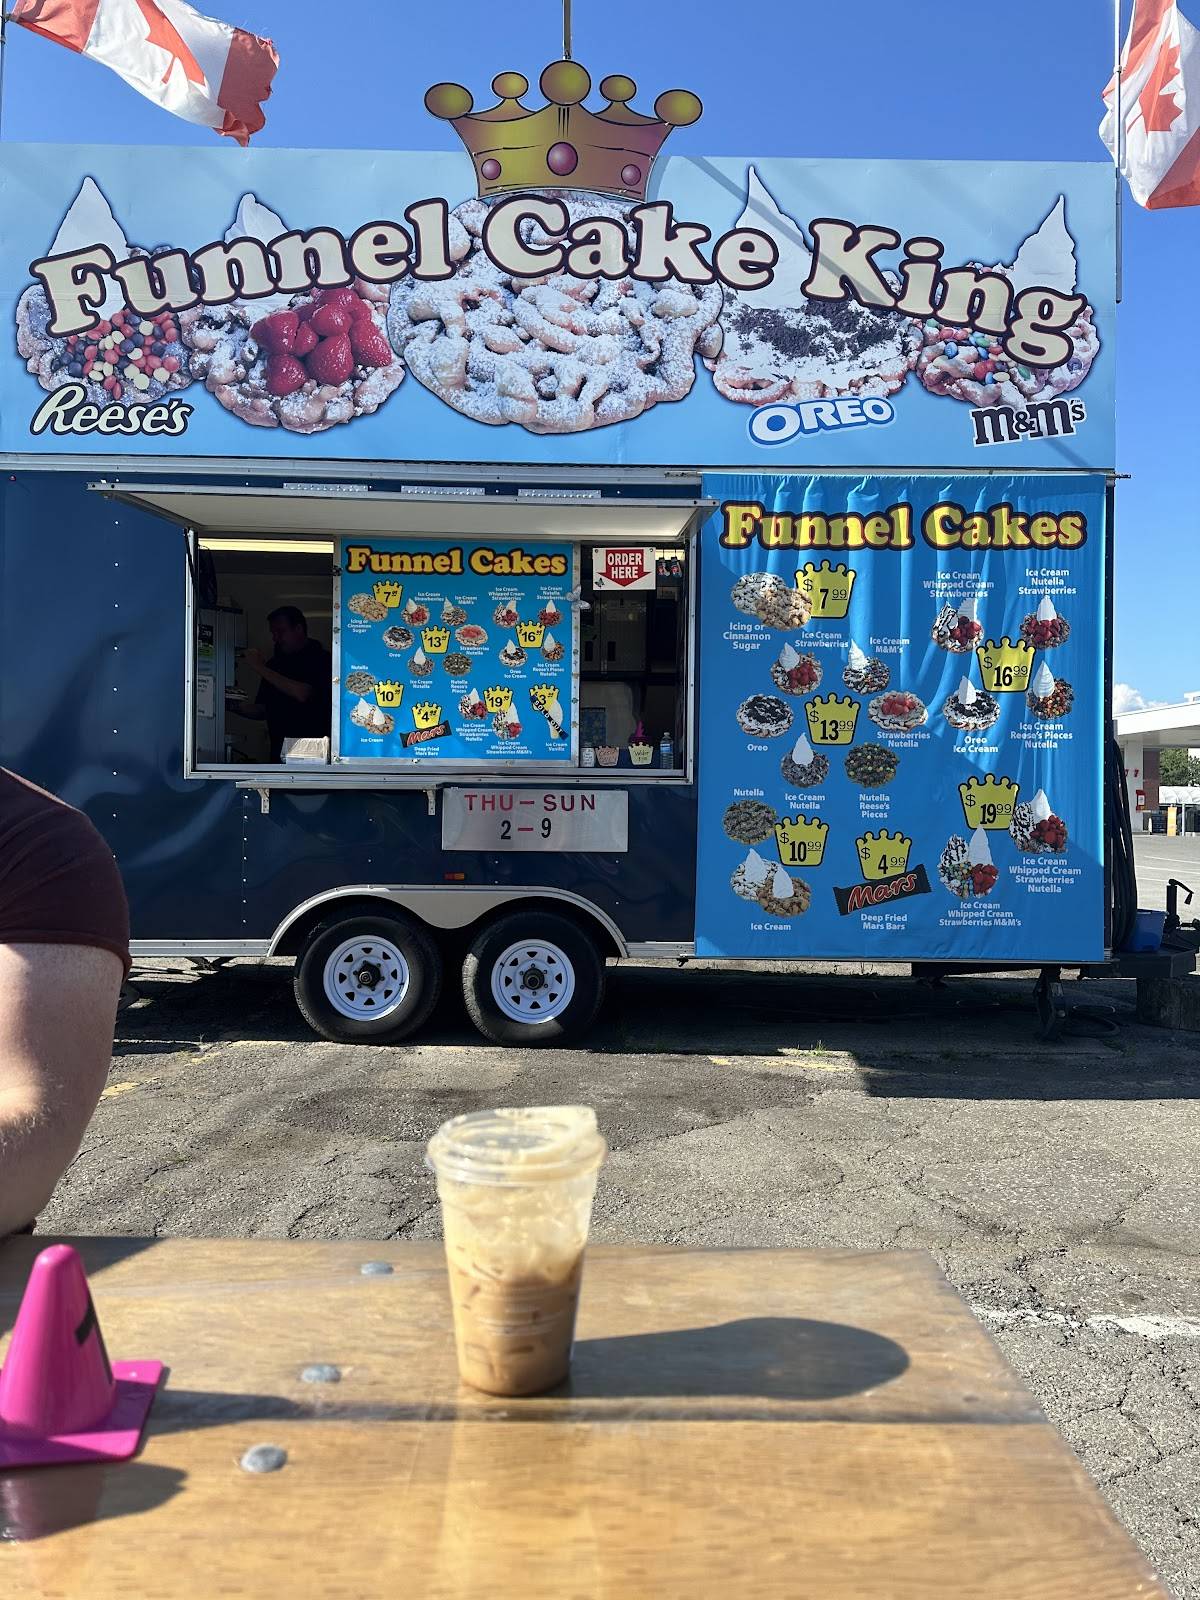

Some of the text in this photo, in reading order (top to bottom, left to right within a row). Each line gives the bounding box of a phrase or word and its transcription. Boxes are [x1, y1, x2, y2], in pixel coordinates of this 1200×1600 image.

[32, 197, 1087, 367] Funnel Cake King
[31, 383, 193, 435] Reese's
[750, 398, 893, 443] OREO
[721, 502, 1086, 549] Funnel Cakes
[347, 546, 567, 575] Funnel Cakes
[607, 553, 642, 566] ORDER
[611, 567, 638, 579] HERE
[937, 571, 950, 579] Ice
[1025, 568, 1069, 577] Ice Cream
[923, 581, 994, 591] Whipped Cream
[1031, 578, 1064, 586] Nutella
[929, 590, 988, 598] Strawberries
[1018, 587, 1076, 595] Strawberries
[730, 622, 750, 632] Icing
[723, 632, 771, 640] Cinnamon
[801, 631, 842, 639] Ice Cream
[733, 642, 760, 651] Sugar
[795, 640, 849, 648] Strawberries
[535, 700, 550, 718] SOLD
[1019, 722, 1064, 730] Ice Cream
[406, 725, 445, 746] Mars
[877, 731, 931, 739] Strawberries
[1010, 731, 1073, 739] Reese's Pieces
[964, 735, 987, 744] Oreo
[888, 740, 919, 748] Nutella
[1025, 740, 1058, 748] Nutella
[953, 745, 998, 753] Ice Cream
[733, 788, 764, 797] Nutella
[785, 793, 825, 801] Ice Cream
[859, 793, 890, 801] Nutella
[859, 802, 890, 810] Reese's
[861, 810, 888, 818] Pieces
[1022, 857, 1067, 865] Ice Cream
[1009, 866, 1082, 876] Whipped Cream
[1015, 875, 1074, 884] Strawberries
[847, 873, 918, 913] Mars
[1028, 885, 1062, 893] Nutella
[960, 901, 1000, 909] Ice Cream
[948, 910, 1013, 918] Whipped Cream
[860, 914, 908, 923] Deep Fried
[939, 918, 1022, 926] Strawberries M&M's
[750, 923, 791, 931] Ice Cream
[862, 922, 905, 930] Mars Bars
